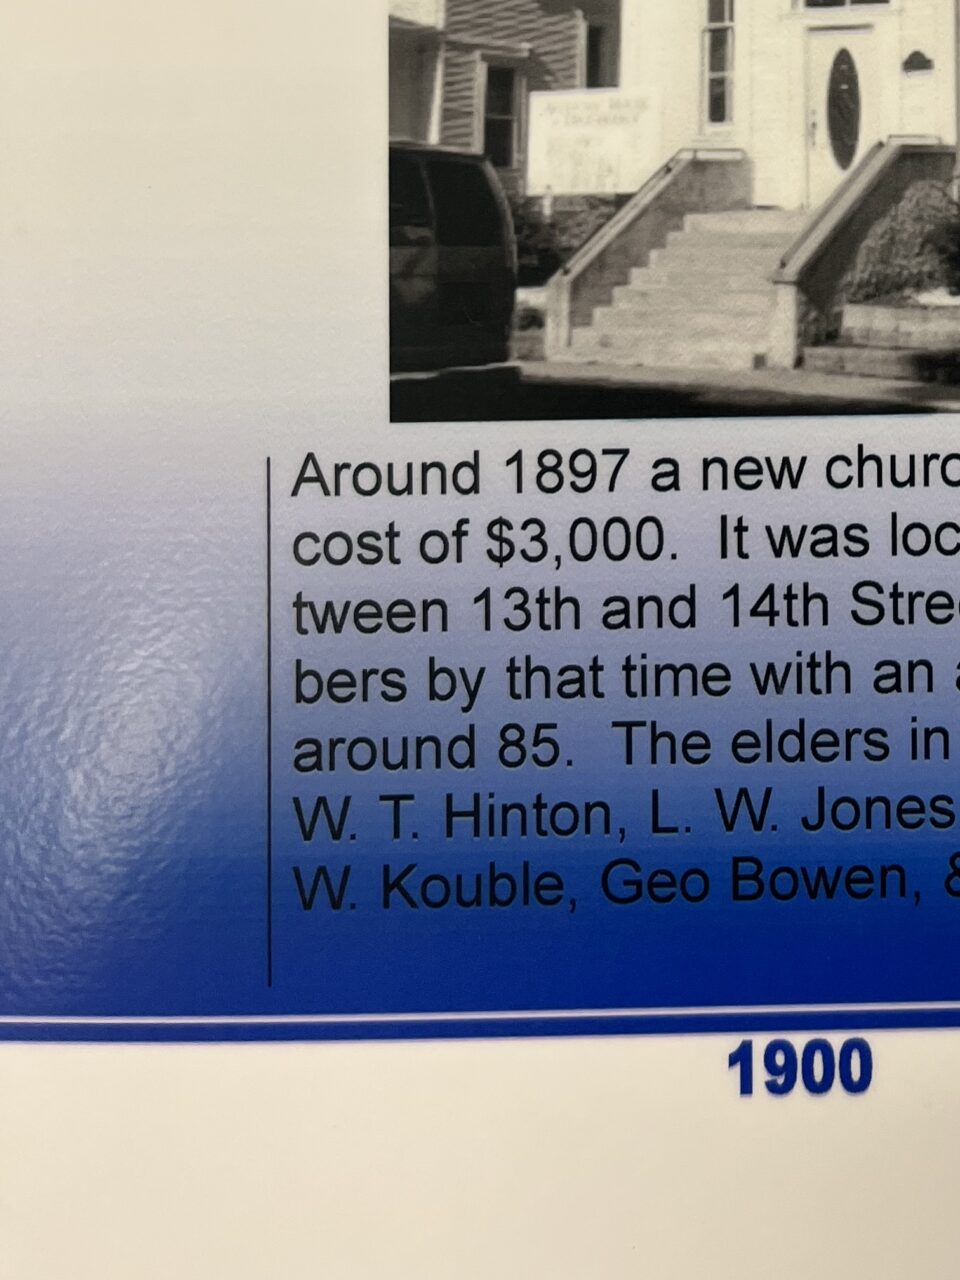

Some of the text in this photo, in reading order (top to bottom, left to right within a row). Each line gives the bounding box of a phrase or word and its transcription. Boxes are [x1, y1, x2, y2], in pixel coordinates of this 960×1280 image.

[291, 450, 479, 496] Around
[506, 449, 629, 493] 1897
[652, 458, 679, 492] a
[703, 456, 806, 490] new
[293, 522, 400, 566] cost
[420, 518, 469, 564] of
[487, 516, 676, 569] $3,000.
[721, 515, 749, 559] It
[766, 524, 869, 558] was
[293, 592, 447, 634] tween
[474, 586, 580, 631] 13th
[602, 584, 695, 629] and
[723, 582, 828, 627] 14th
[296, 659, 406, 703] bers
[429, 657, 485, 713] by
[506, 655, 604, 699] that
[622, 654, 731, 698] time
[750, 651, 850, 695] with
[874, 660, 933, 693] an
[294, 724, 475, 772] around
[499, 723, 572, 767] 85.
[612, 721, 710, 764] The
[732, 719, 889, 763] elders
[912, 717, 949, 760] in
[293, 796, 355, 841] W.
[379, 794, 417, 838] T.
[446, 793, 625, 842] Hinton,
[652, 790, 690, 833] L.
[715, 788, 776, 831] W.
[293, 866, 355, 910] W.
[383, 862, 575, 912] Kouble,
[602, 858, 709, 904] Geo
[733, 857, 920, 905] Bowen,
[728, 1037, 873, 1095] 1900
